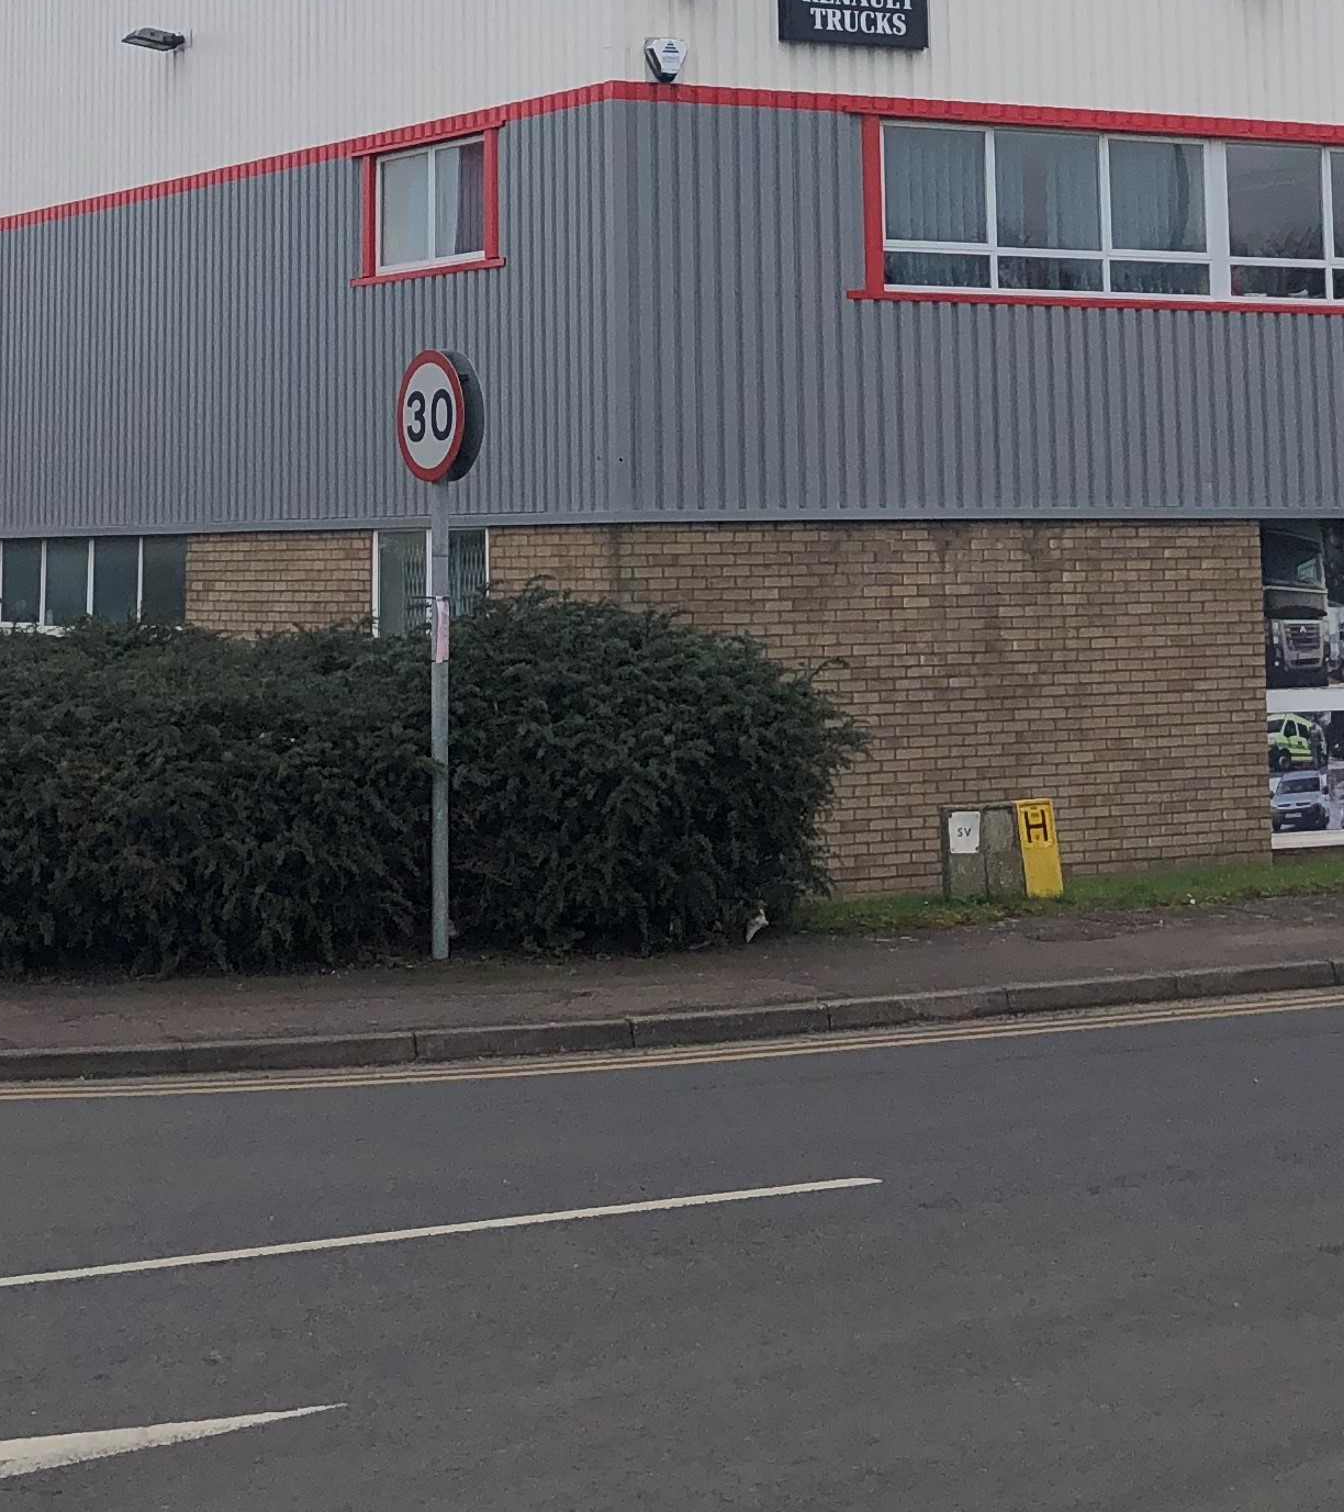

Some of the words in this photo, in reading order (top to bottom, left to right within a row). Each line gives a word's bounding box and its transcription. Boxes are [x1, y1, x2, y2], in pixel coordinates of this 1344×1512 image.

[810, 8, 907, 36] TRUCKS
[407, 389, 452, 442] 30
[957, 827, 972, 837] SV
[1024, 809, 1048, 843] H
